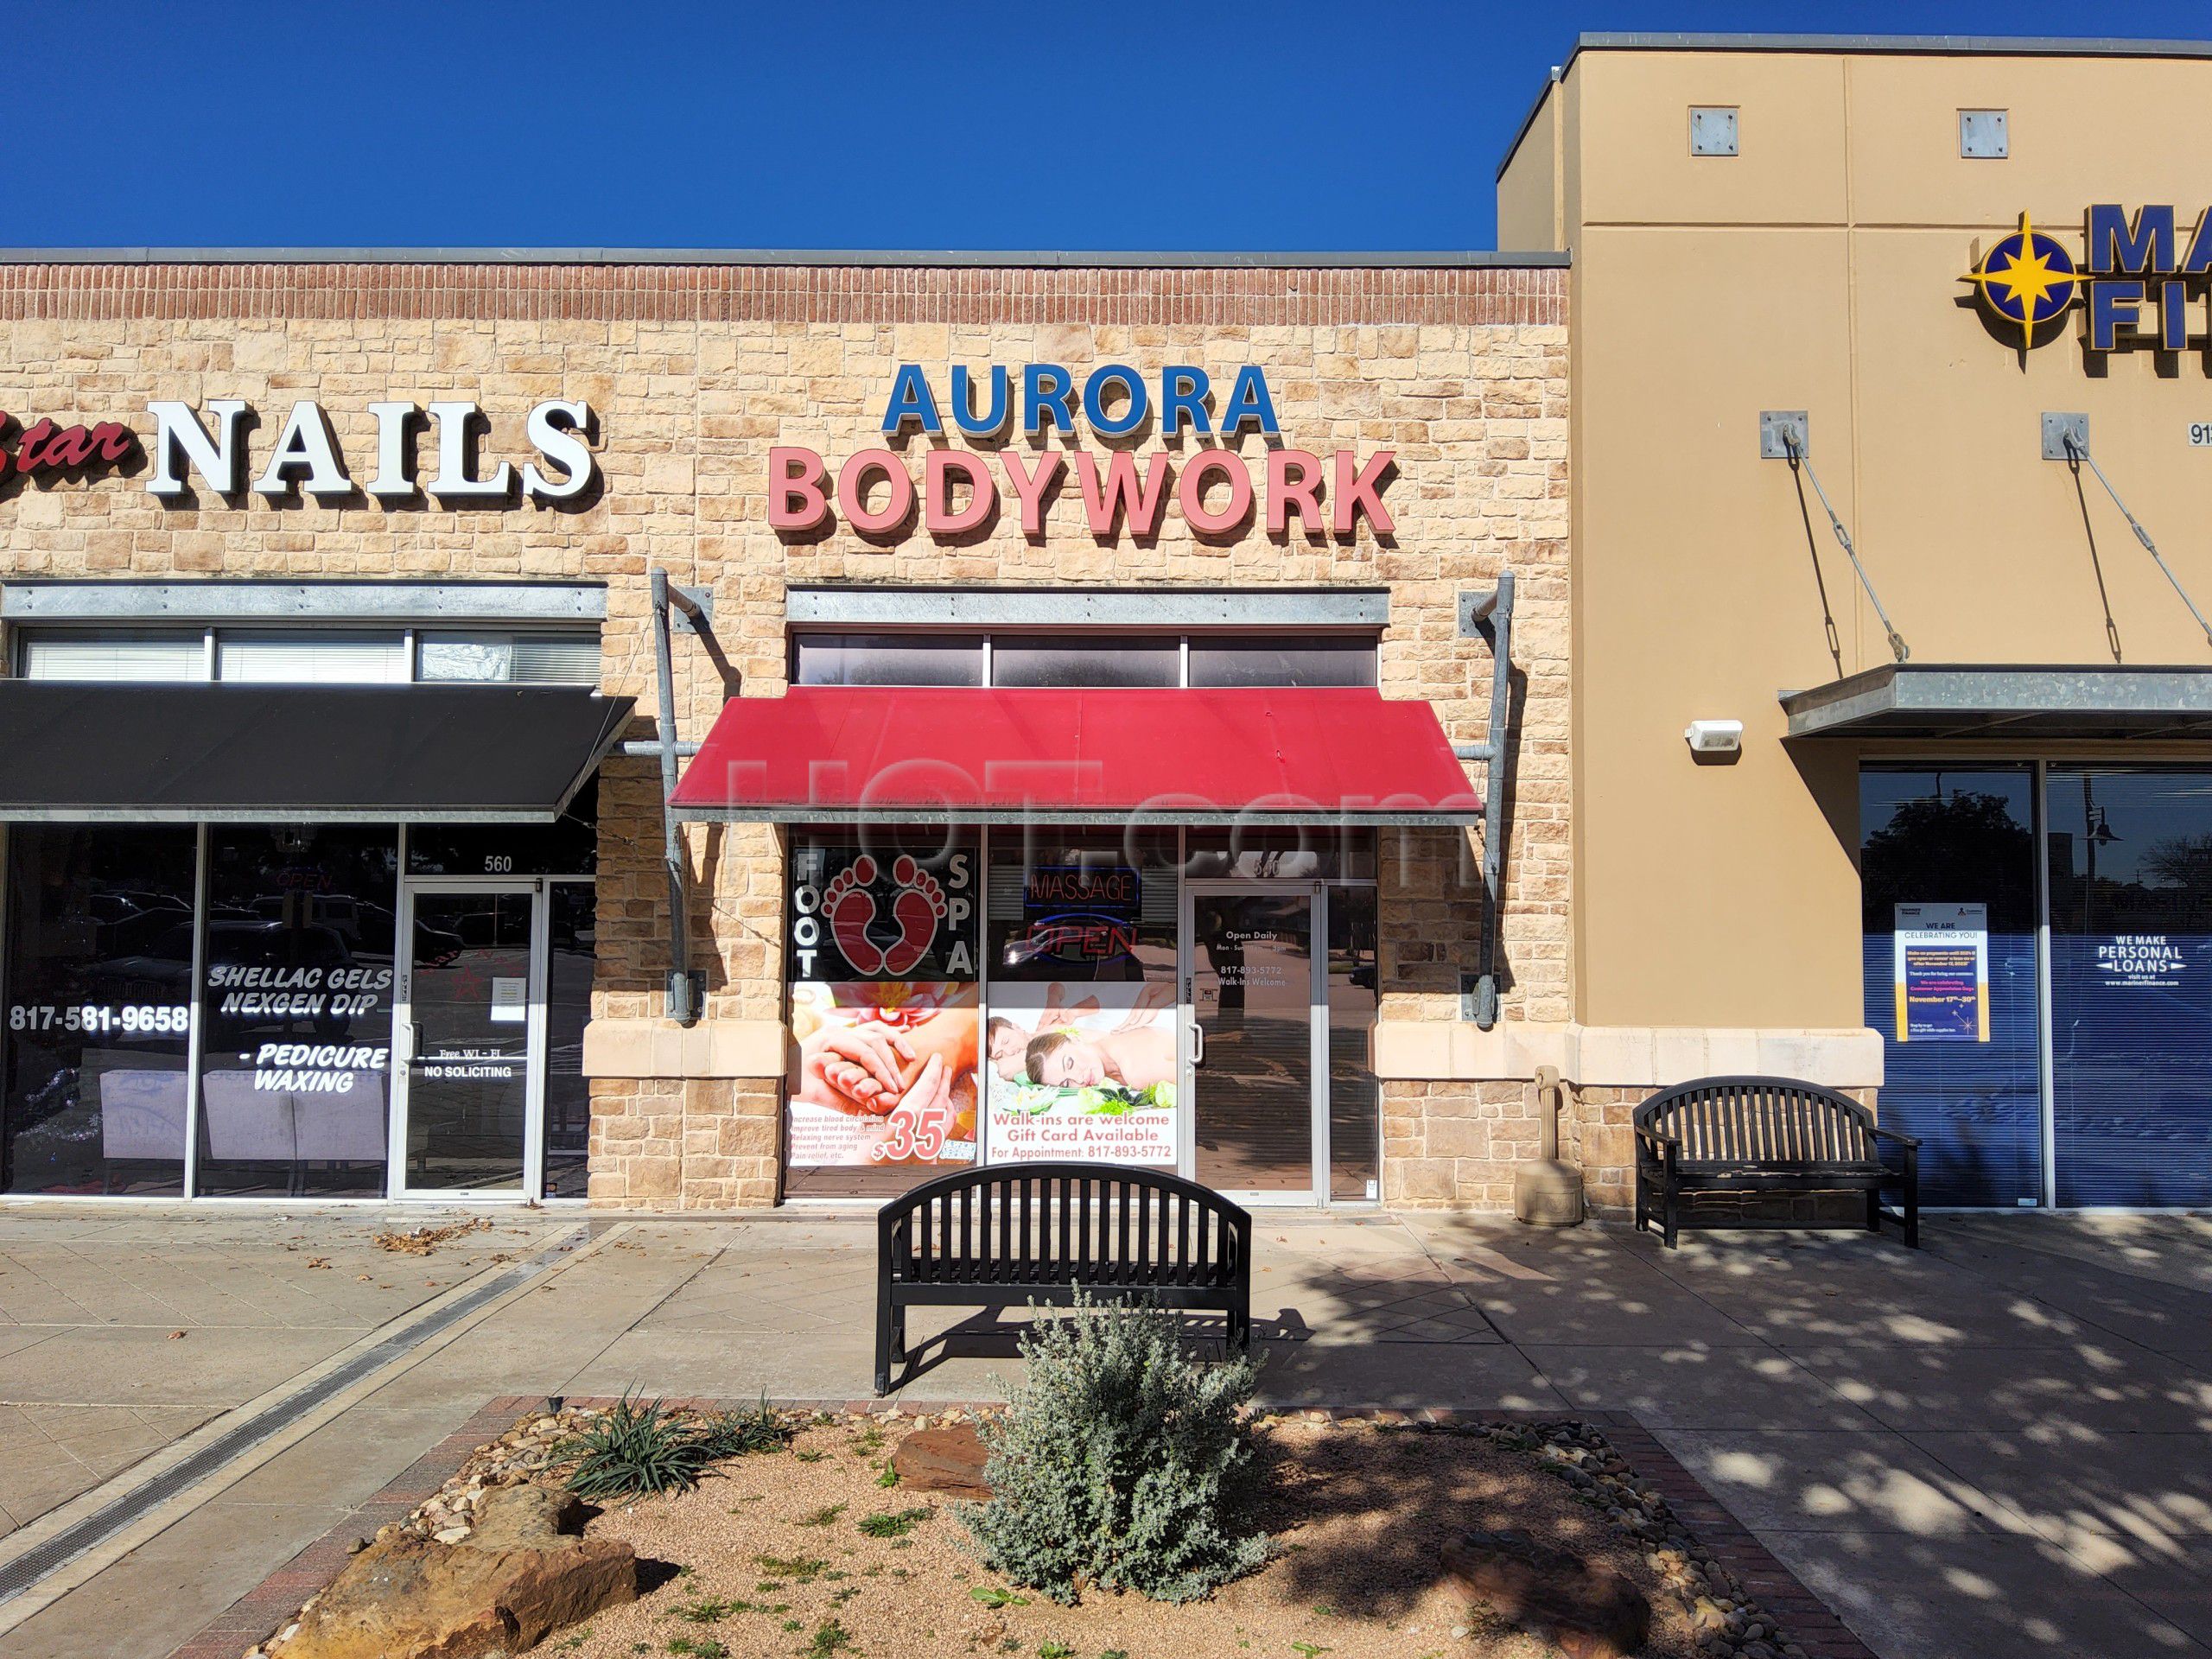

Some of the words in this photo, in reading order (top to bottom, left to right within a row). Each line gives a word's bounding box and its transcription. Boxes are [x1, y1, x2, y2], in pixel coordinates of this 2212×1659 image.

[881, 364, 1281, 439] AURORA
[2190, 424, 2212, 444] 91
[145, 400, 593, 498] NAILS
[769, 446, 1398, 535] BODYWORK
[484, 855, 512, 872] 560
[1031, 874, 1132, 900] MASSAGE
[794, 853, 821, 977] FOOT
[946, 854, 974, 975] SPA
[1027, 925, 1137, 954] OPEN
[1226, 931, 1251, 942] Open
[1254, 931, 1278, 942] Daily
[2115, 935, 2133, 945] WE
[2135, 935, 2167, 945] MAKE
[2099, 945, 2183, 959] PERSONAL
[1220, 965, 1281, 974] 817-893-5772
[2113, 959, 2167, 972] LOANS
[207, 966, 322, 989] SHELLAC
[327, 968, 393, 990] GELS
[1217, 976, 1250, 986] Walk-Ins
[1252, 976, 1286, 987] Welcome
[220, 992, 326, 1014] NEXGEN
[330, 994, 378, 1015] DIP
[10, 1005, 188, 1031] 817-581-9658
[257, 1043, 389, 1069] PEDICURE
[439, 1049, 461, 1058] Free
[424, 1065, 442, 1077] NO
[445, 1066, 512, 1077] SOLICITING
[254, 1070, 354, 1093] WAXING
[845, 1114, 884, 1122] circulation
[994, 1113, 1063, 1125] Walk-ins
[1068, 1115, 1093, 1125] are
[1099, 1113, 1170, 1125] welcome
[841, 1124, 857, 1133] body
[872, 1109, 946, 1160] $35
[1007, 1128, 1036, 1141] Gift
[1041, 1128, 1078, 1141] Card
[1084, 1128, 1160, 1141] Available
[838, 1143, 858, 1152] aging
[991, 1147, 1009, 1158] For
[1012, 1147, 1084, 1160] Appointment:
[1088, 1145, 1172, 1157] 817-893-5772
